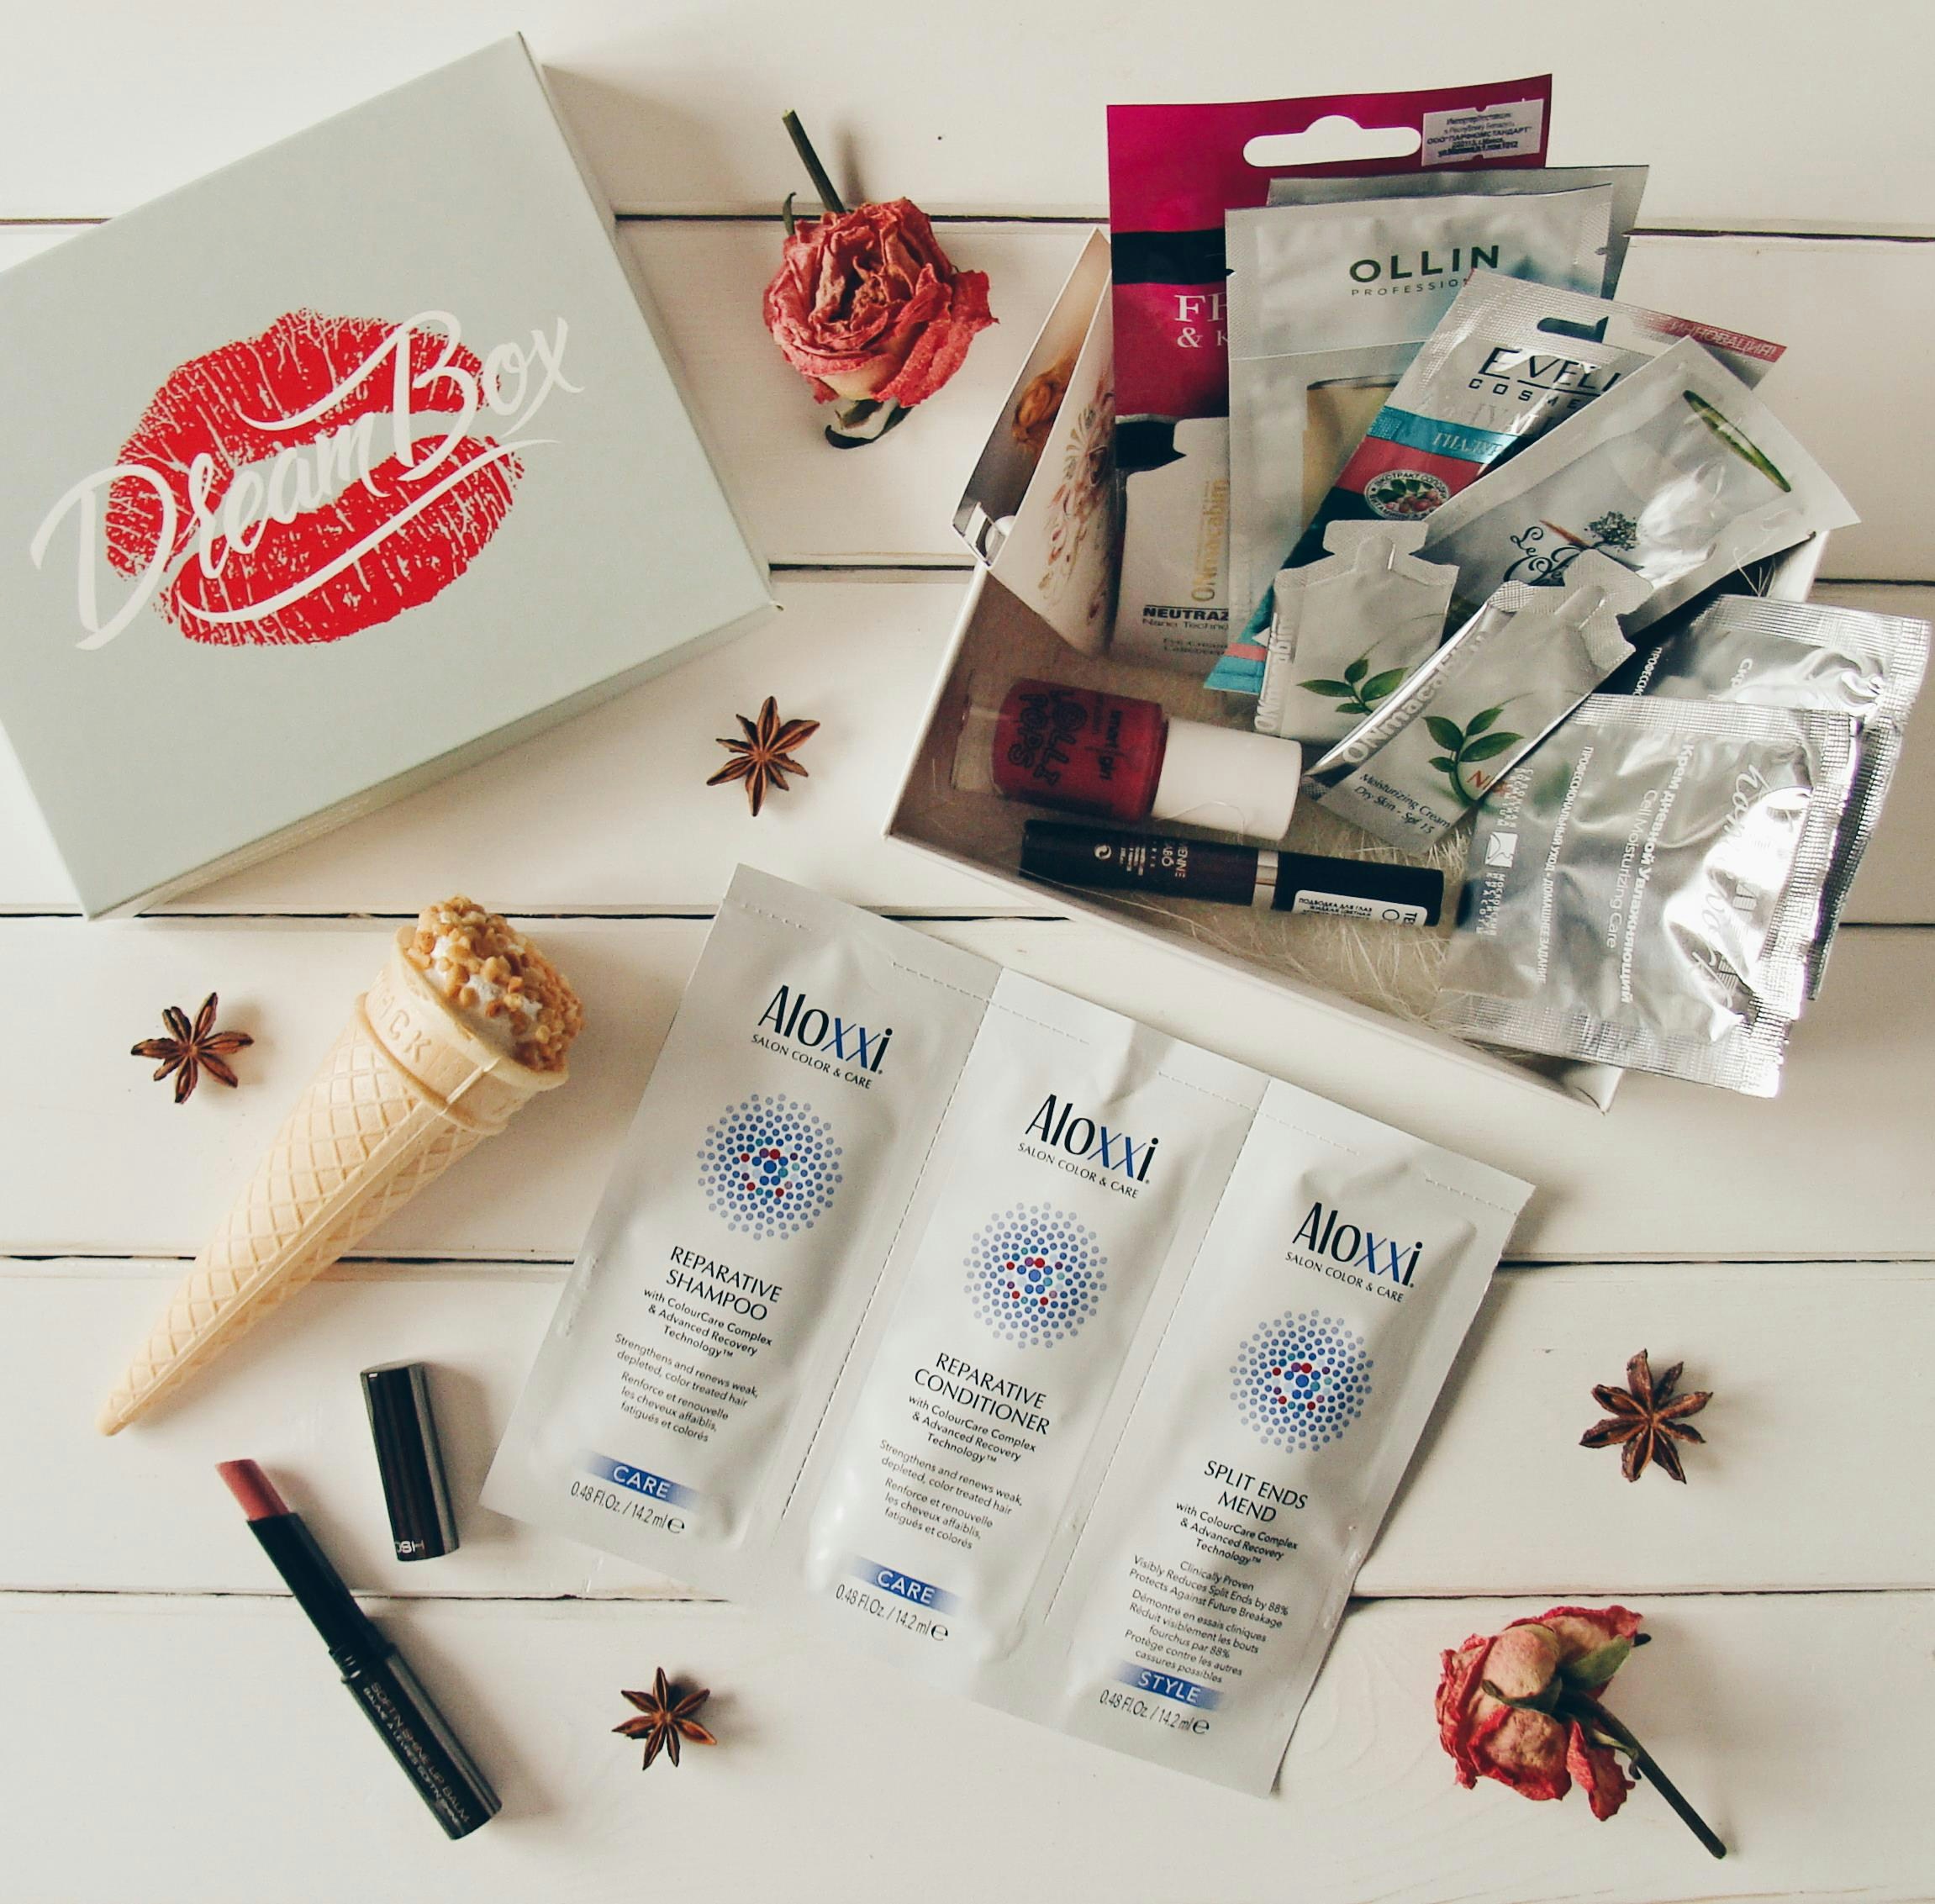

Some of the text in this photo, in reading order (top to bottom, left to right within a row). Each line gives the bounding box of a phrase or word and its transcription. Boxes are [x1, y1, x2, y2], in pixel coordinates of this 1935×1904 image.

[1350, 245, 1499, 282] OLLIN
[1352, 278, 1468, 296] PROFESSIO
[1177, 327, 1203, 348] &
[1479, 347, 1621, 393] EVELI
[30, 310, 585, 650] Dream Box
[1354, 785, 1436, 835] Dry Skin Spf 15
[1359, 773, 1451, 831] Moisturizing Cream
[1553, 746, 1594, 847] ПРОФЕССИОНАЛЬНЫЙ
[1544, 846, 1559, 872] УХОД
[1606, 789, 1658, 948] Cell Moisturizing Care
[1621, 744, 1695, 1003] Крем Дневной Увлажняющий
[1540, 878, 1553, 939] ДОМАШНЕЕ
[751, 1033, 873, 1089] SALON COLOR & CARE
[1018, 1142, 1139, 1199] SALON COLOR & CARE
[666, 1269, 767, 1321] SHAMPOO
[670, 1246, 783, 1303] REPARATIVE
[1285, 1252, 1404, 1302] SALON COLOR & CARE
[644, 1289, 772, 1346] with ColourCare Complex
[648, 1304, 758, 1356] & Advanced Recovery
[615, 1333, 759, 1399] Strengthens and renews weak,
[617, 1350, 748, 1407] depleted, color treated hair
[936, 1353, 1047, 1409] REPARATIVE
[621, 1371, 729, 1421] Renforce et renouvelle
[621, 1386, 717, 1432] les cheveux affaiblis,
[915, 1369, 1050, 1434] CONDITIONER
[620, 1401, 709, 1443] fatigués et colorés
[909, 1395, 1036, 1453] with ColourCare Complex
[912, 1412, 1022, 1462] & Advanced Recovery
[613, 1466, 672, 1498] CARE
[880, 1440, 1023, 1506] Strengthens and renews weak,
[881, 1457, 1013, 1515] depleted, color treated hair
[1205, 1460, 1308, 1509] SPLIT ENDS
[571, 1481, 592, 1501] 0.48
[631, 1503, 653, 1523] 14.2
[884, 1478, 993, 1527] Renforce et renouvelle
[885, 1492, 981, 1539] les cheveux affaiblis,
[1176, 1501, 1298, 1550] with ColourCare Complex
[1218, 1491, 1276, 1522] MEND
[884, 1508, 973, 1549] fatigués et colorés
[1180, 1517, 1284, 1560] & Advanced Recovery
[877, 1570, 935, 1604] CARE
[1129, 1569, 1283, 1629] Protects Against Future Breakage
[1133, 1554, 1289, 1616] Visibly Reduces Split Ends by 88%
[1180, 1560, 1254, 1592] Clinically Proven
[836, 1585, 857, 1604] 0.48
[895, 1609, 916, 1629] 14.2
[1129, 1603, 1259, 1654] Réduit visiblement les bouts
[1132, 1589, 1267, 1643] Démontré en essais cliniques
[1125, 1629, 1242, 1676] Protège contre les autres
[1136, 1649, 1222, 1684] cassures possibles
[1148, 1624, 1231, 1659] fourchus par 88%
[1099, 1690, 1181, 1727] 0.48 14.2
[1138, 1670, 1201, 1702] STYLE
